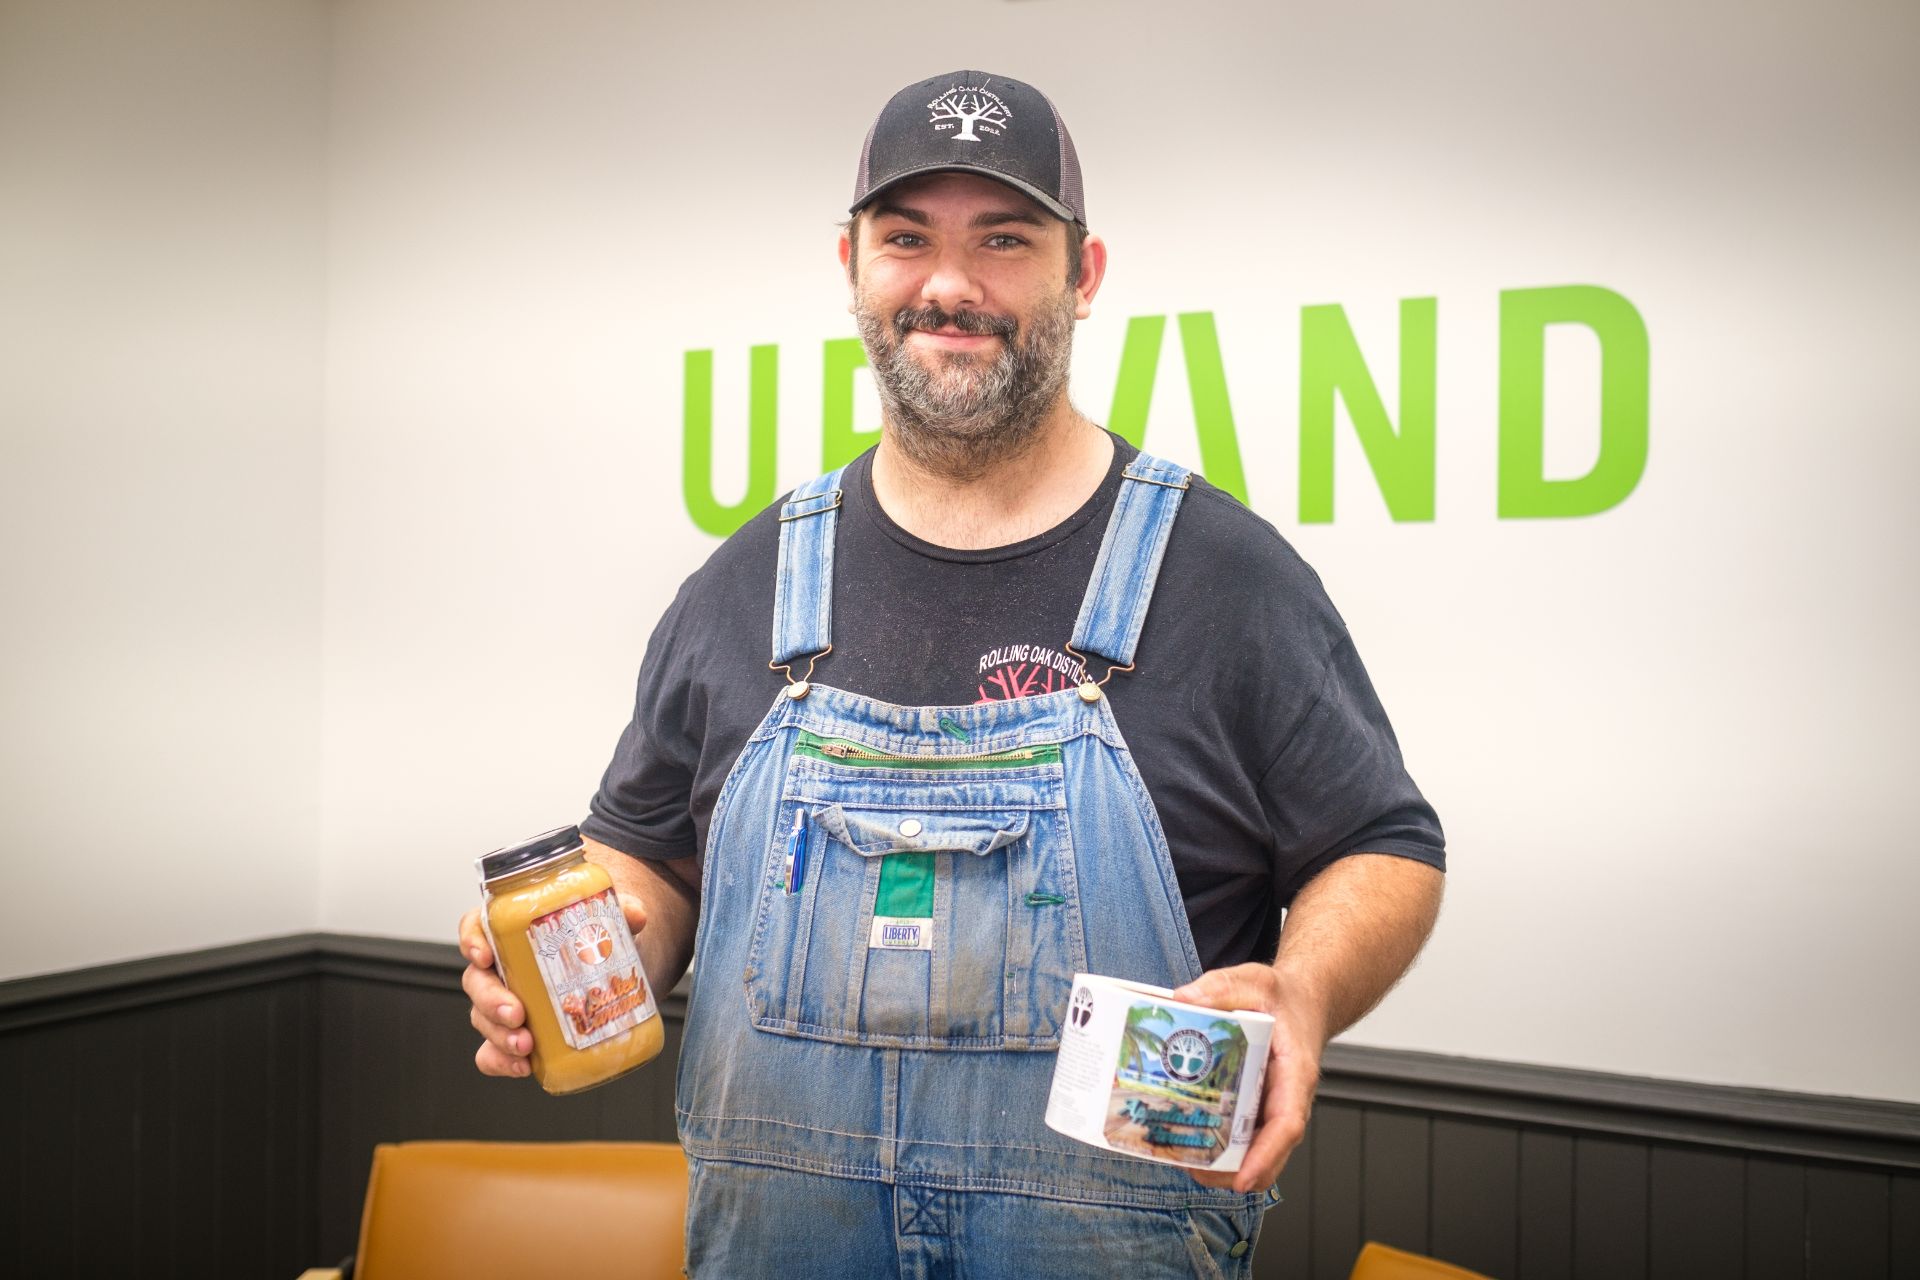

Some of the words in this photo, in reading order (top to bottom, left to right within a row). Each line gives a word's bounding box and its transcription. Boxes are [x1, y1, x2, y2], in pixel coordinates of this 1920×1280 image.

[681, 284, 1652, 538] UPAND
[979, 644, 1030, 674] ROLLING
[1030, 645, 1054, 667] OAK
[566, 903, 587, 926] Oak
[884, 926, 918, 940] LIBERTY
